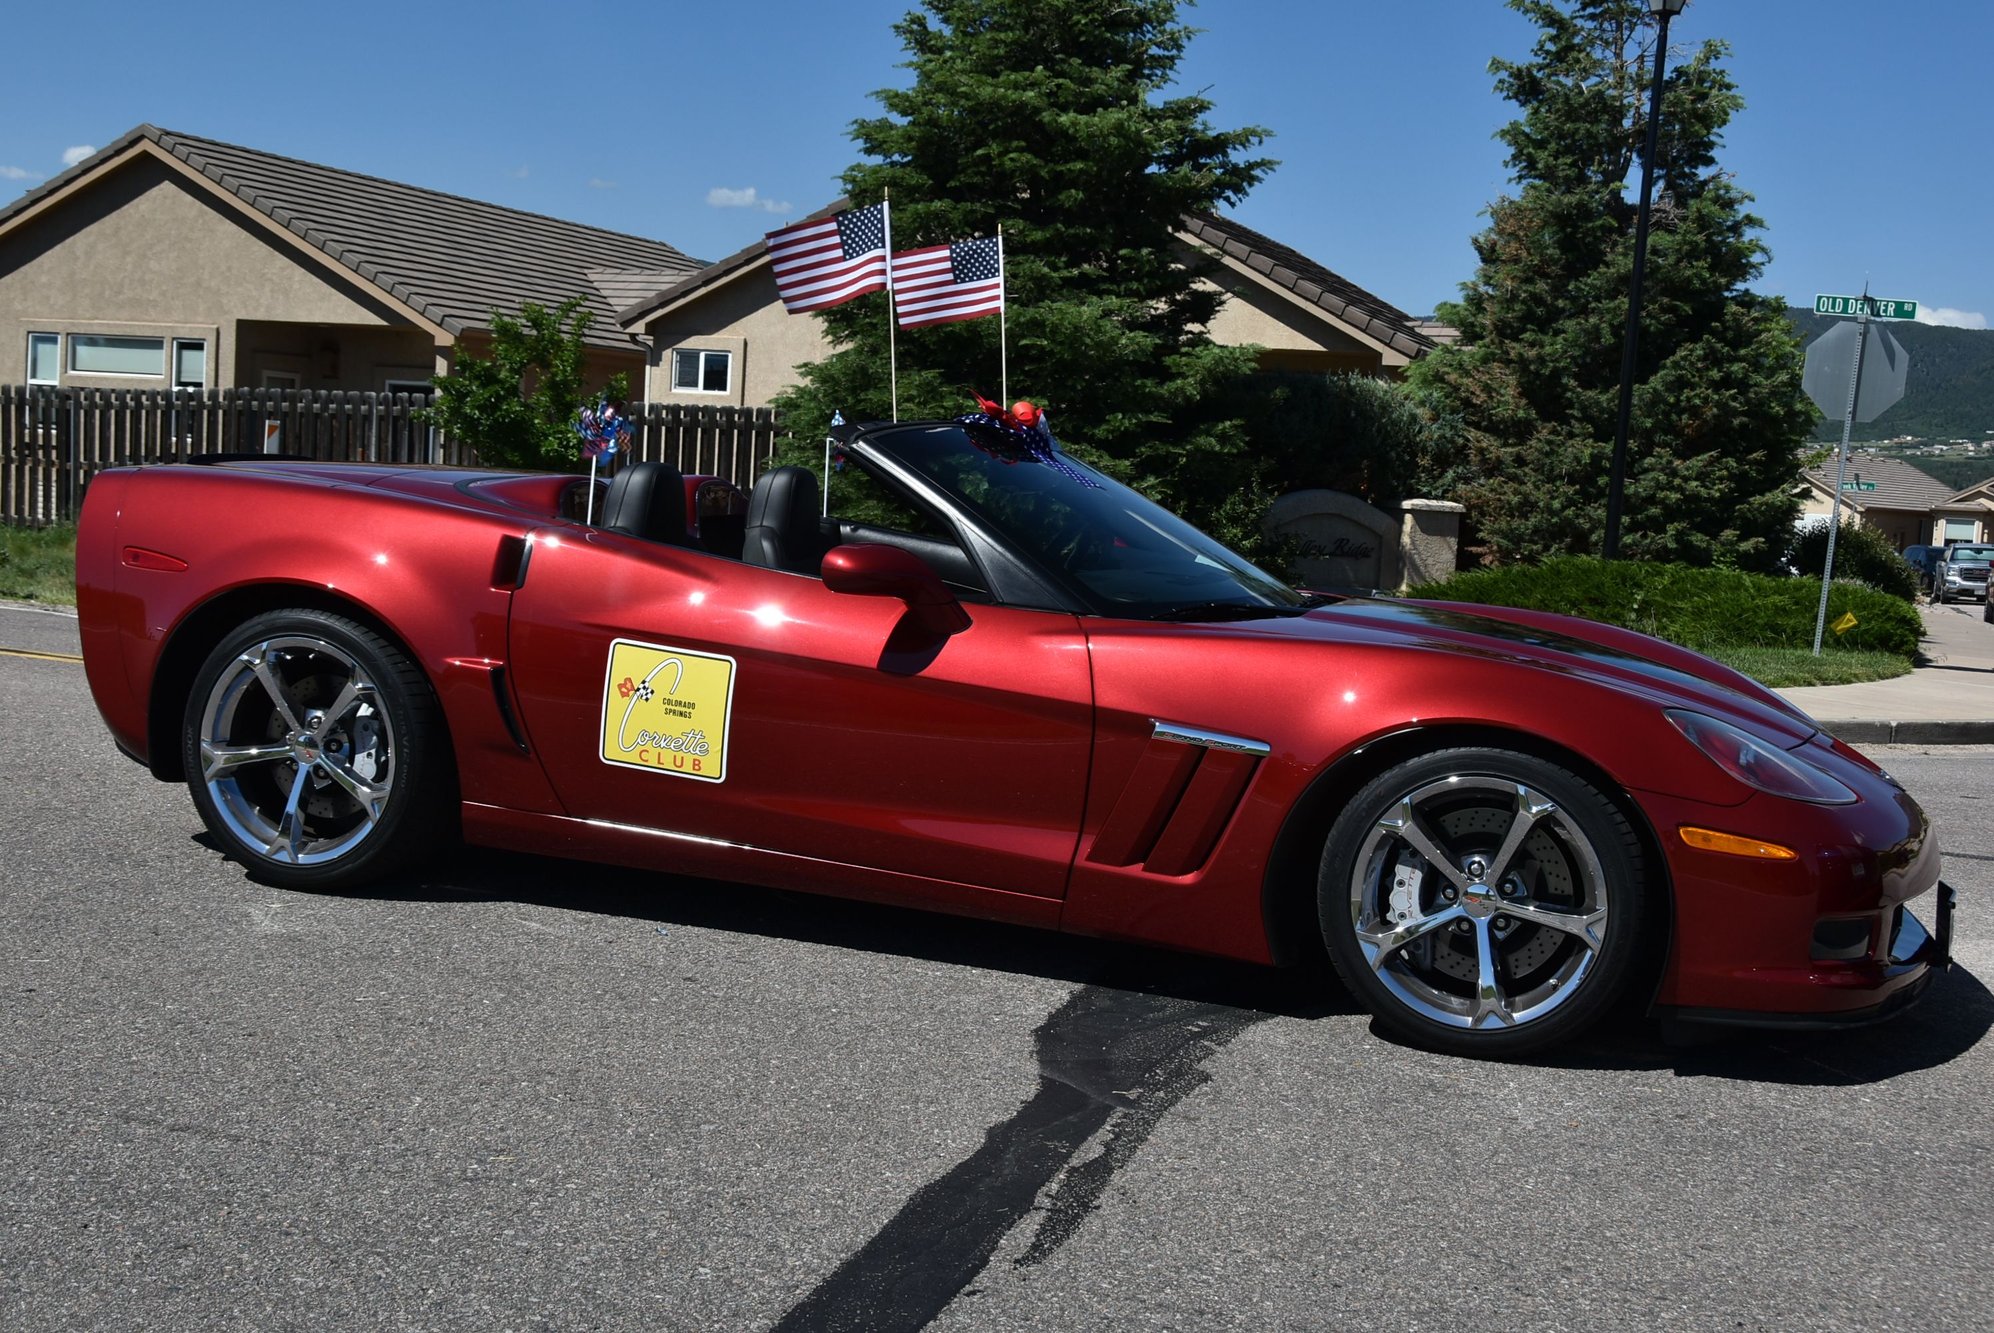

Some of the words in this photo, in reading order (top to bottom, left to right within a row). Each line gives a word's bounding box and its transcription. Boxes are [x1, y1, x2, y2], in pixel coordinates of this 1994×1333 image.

[1819, 297, 1844, 313] OLD
[1847, 299, 1896, 317] DENVER
[1903, 302, 1913, 312] RD
[618, 657, 709, 757] Corvette
[662, 697, 696, 710] COLORADO
[664, 707, 692, 719] SPRINGS
[638, 749, 702, 772] CLUB
